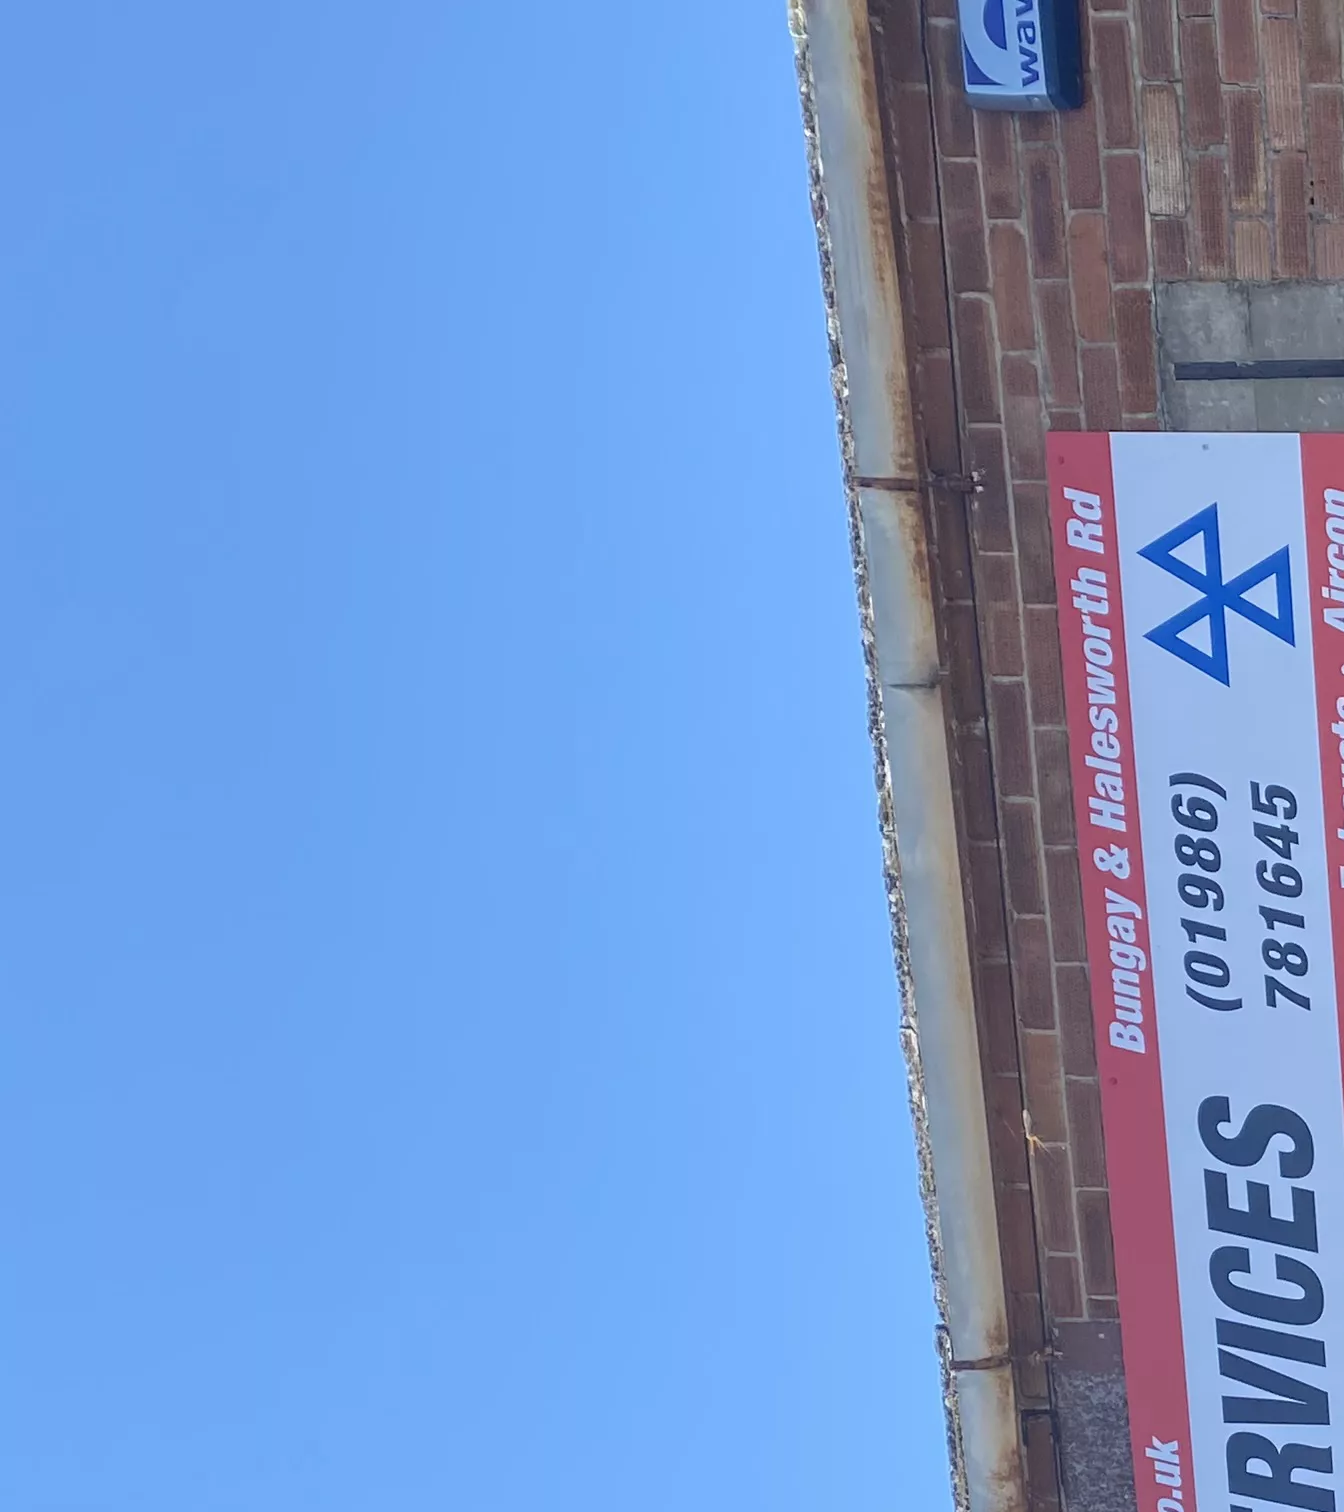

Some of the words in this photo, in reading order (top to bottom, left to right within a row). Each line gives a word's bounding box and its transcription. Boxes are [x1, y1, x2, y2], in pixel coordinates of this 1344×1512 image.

[1064, 487, 1104, 554] Rd
[1071, 568, 1126, 832] Halesworth
[1094, 847, 1130, 879] &
[1169, 773, 1242, 1011] (01986)
[1250, 781, 1311, 1011] 781645
[1105, 888, 1146, 1053] Bungay
